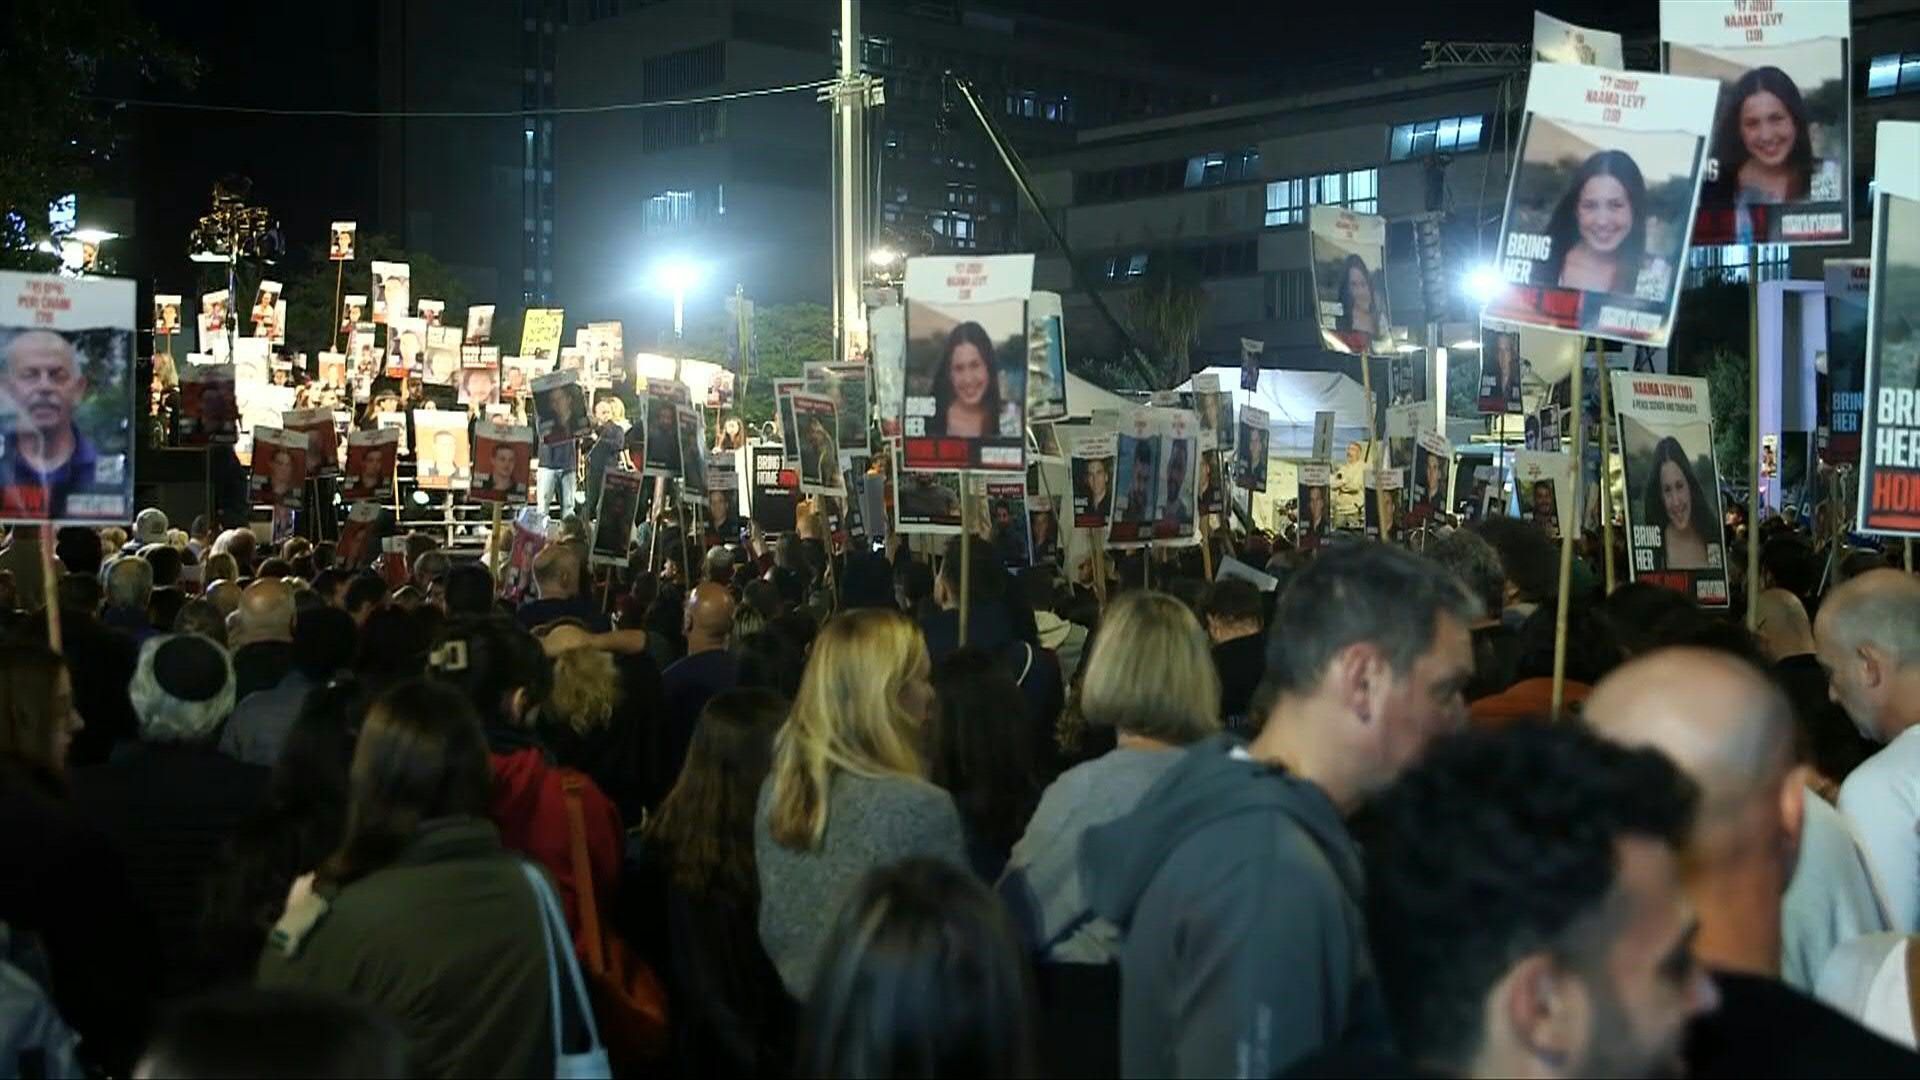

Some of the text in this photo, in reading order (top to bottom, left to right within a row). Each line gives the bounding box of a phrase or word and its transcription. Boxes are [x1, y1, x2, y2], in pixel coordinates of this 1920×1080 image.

[1761, 12, 1783, 26] LEVY
[1622, 94, 1646, 109] LEVY
[1505, 231, 1552, 261] BRING
[1503, 257, 1533, 285] HER
[1832, 391, 1864, 412] BRIN
[1832, 412, 1857, 432] HER
[757, 455, 780, 470] BRING
[1633, 525, 1661, 547] BRING
[1635, 548, 1655, 571] HER
